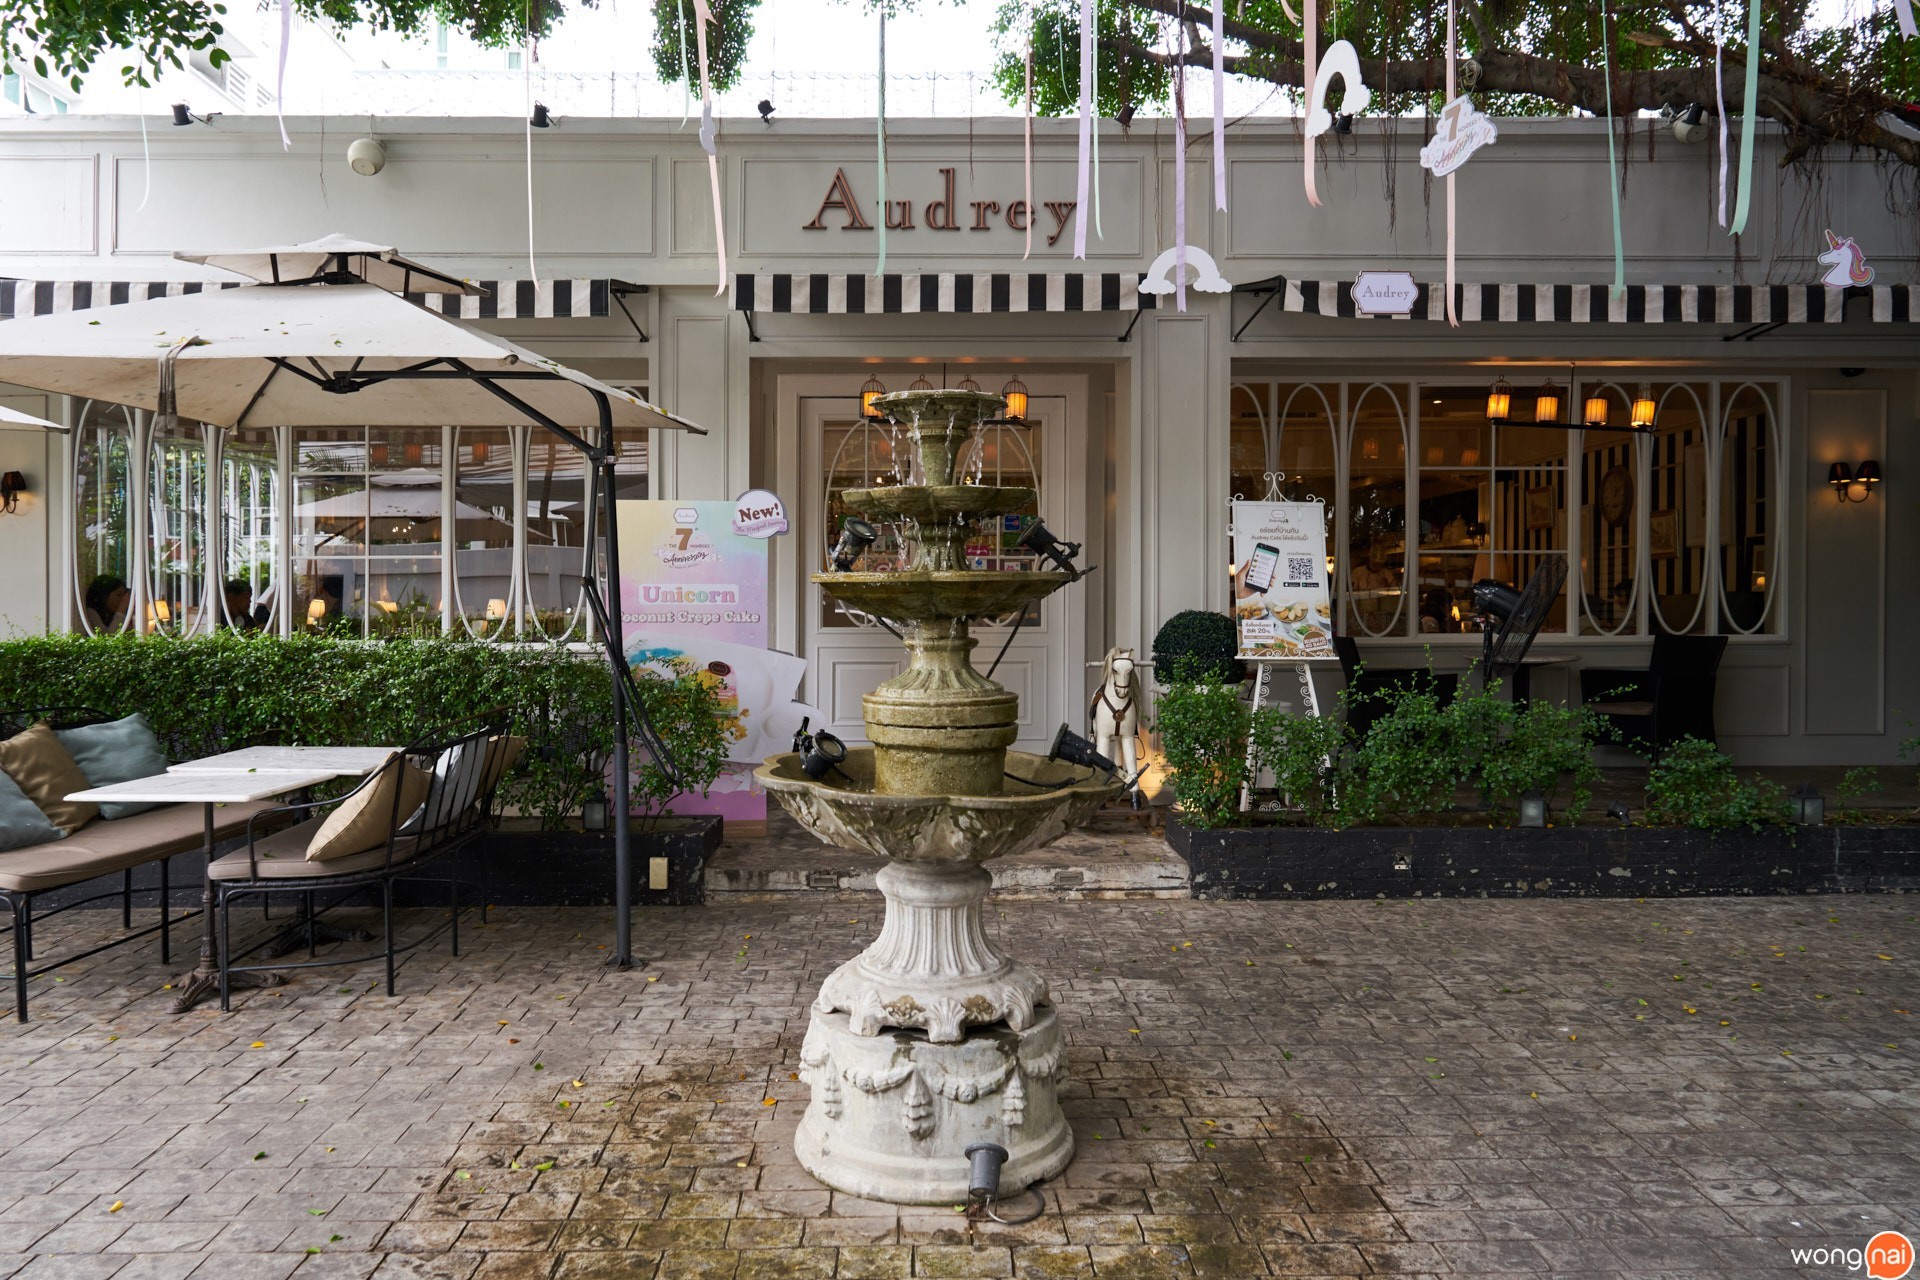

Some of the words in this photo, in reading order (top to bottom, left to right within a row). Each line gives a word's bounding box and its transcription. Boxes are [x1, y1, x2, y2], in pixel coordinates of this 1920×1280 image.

[1444, 104, 1462, 142] 7
[802, 166, 1078, 247] Audrey
[1361, 285, 1410, 300] Audrey
[738, 502, 780, 523] New!
[675, 528, 693, 551] 7
[641, 586, 736, 603] Unicorn
[677, 610, 721, 625] Crepe
[723, 610, 761, 624] Cake
